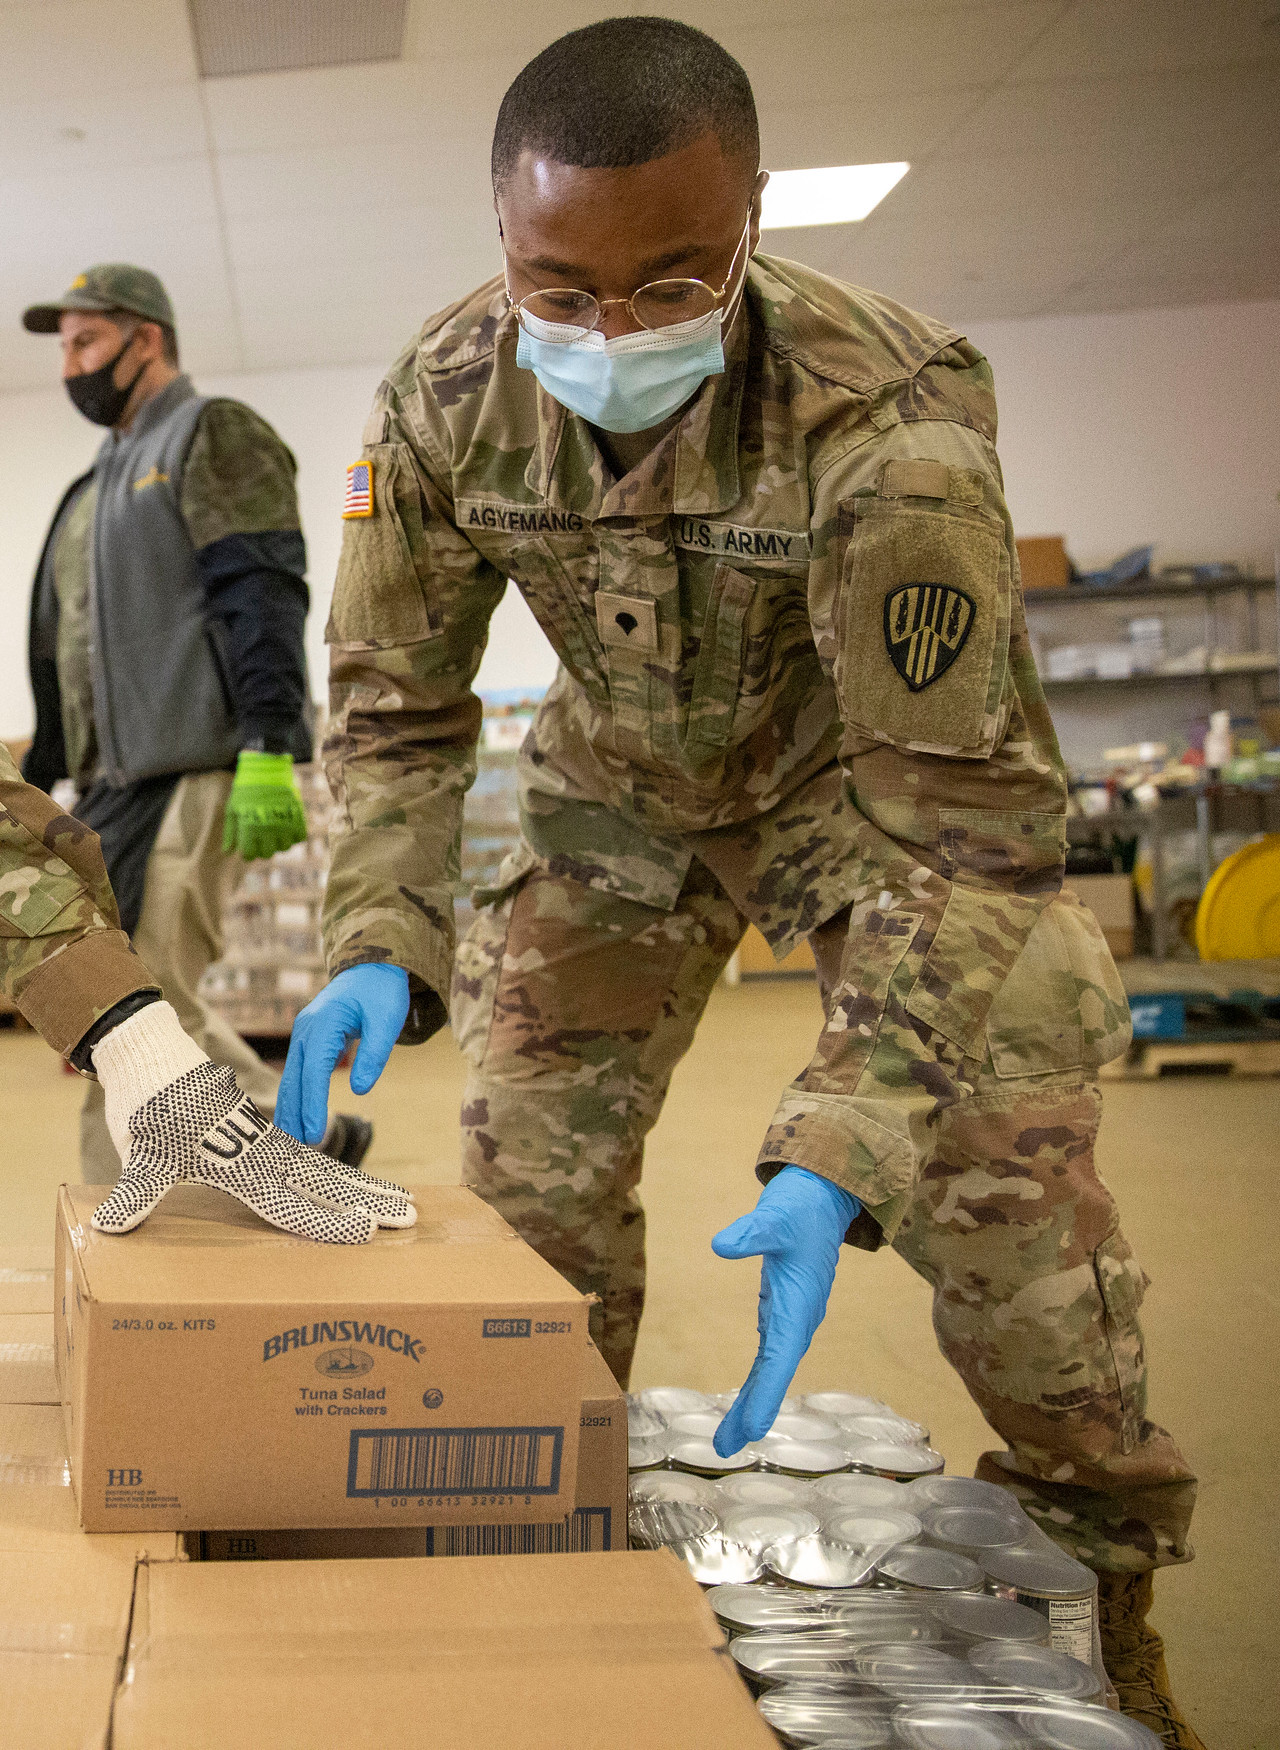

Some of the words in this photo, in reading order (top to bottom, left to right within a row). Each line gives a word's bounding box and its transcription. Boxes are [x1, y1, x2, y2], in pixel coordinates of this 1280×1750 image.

[468, 506, 584, 532] AGYEMANG
[680, 520, 716, 549] U.S.
[724, 528, 793, 556] ARMY
[111, 1319, 154, 1331] 24/3.0
[158, 1321, 178, 1331] oz.
[183, 1319, 216, 1331] KITS
[486, 1321, 527, 1334] 66613
[534, 1321, 572, 1334] 32921
[262, 1320, 422, 1364] BRUNSWICK
[299, 1387, 338, 1400] Tuna
[342, 1387, 387, 1400] Salad
[295, 1404, 324, 1416] with
[327, 1404, 388, 1416] Crackers
[579, 1416, 612, 1427] 32921
[106, 1469, 143, 1487] HB
[417, 1496, 461, 1507] 66613
[471, 1495, 514, 1506] 32921
[227, 1537, 257, 1554] HB
